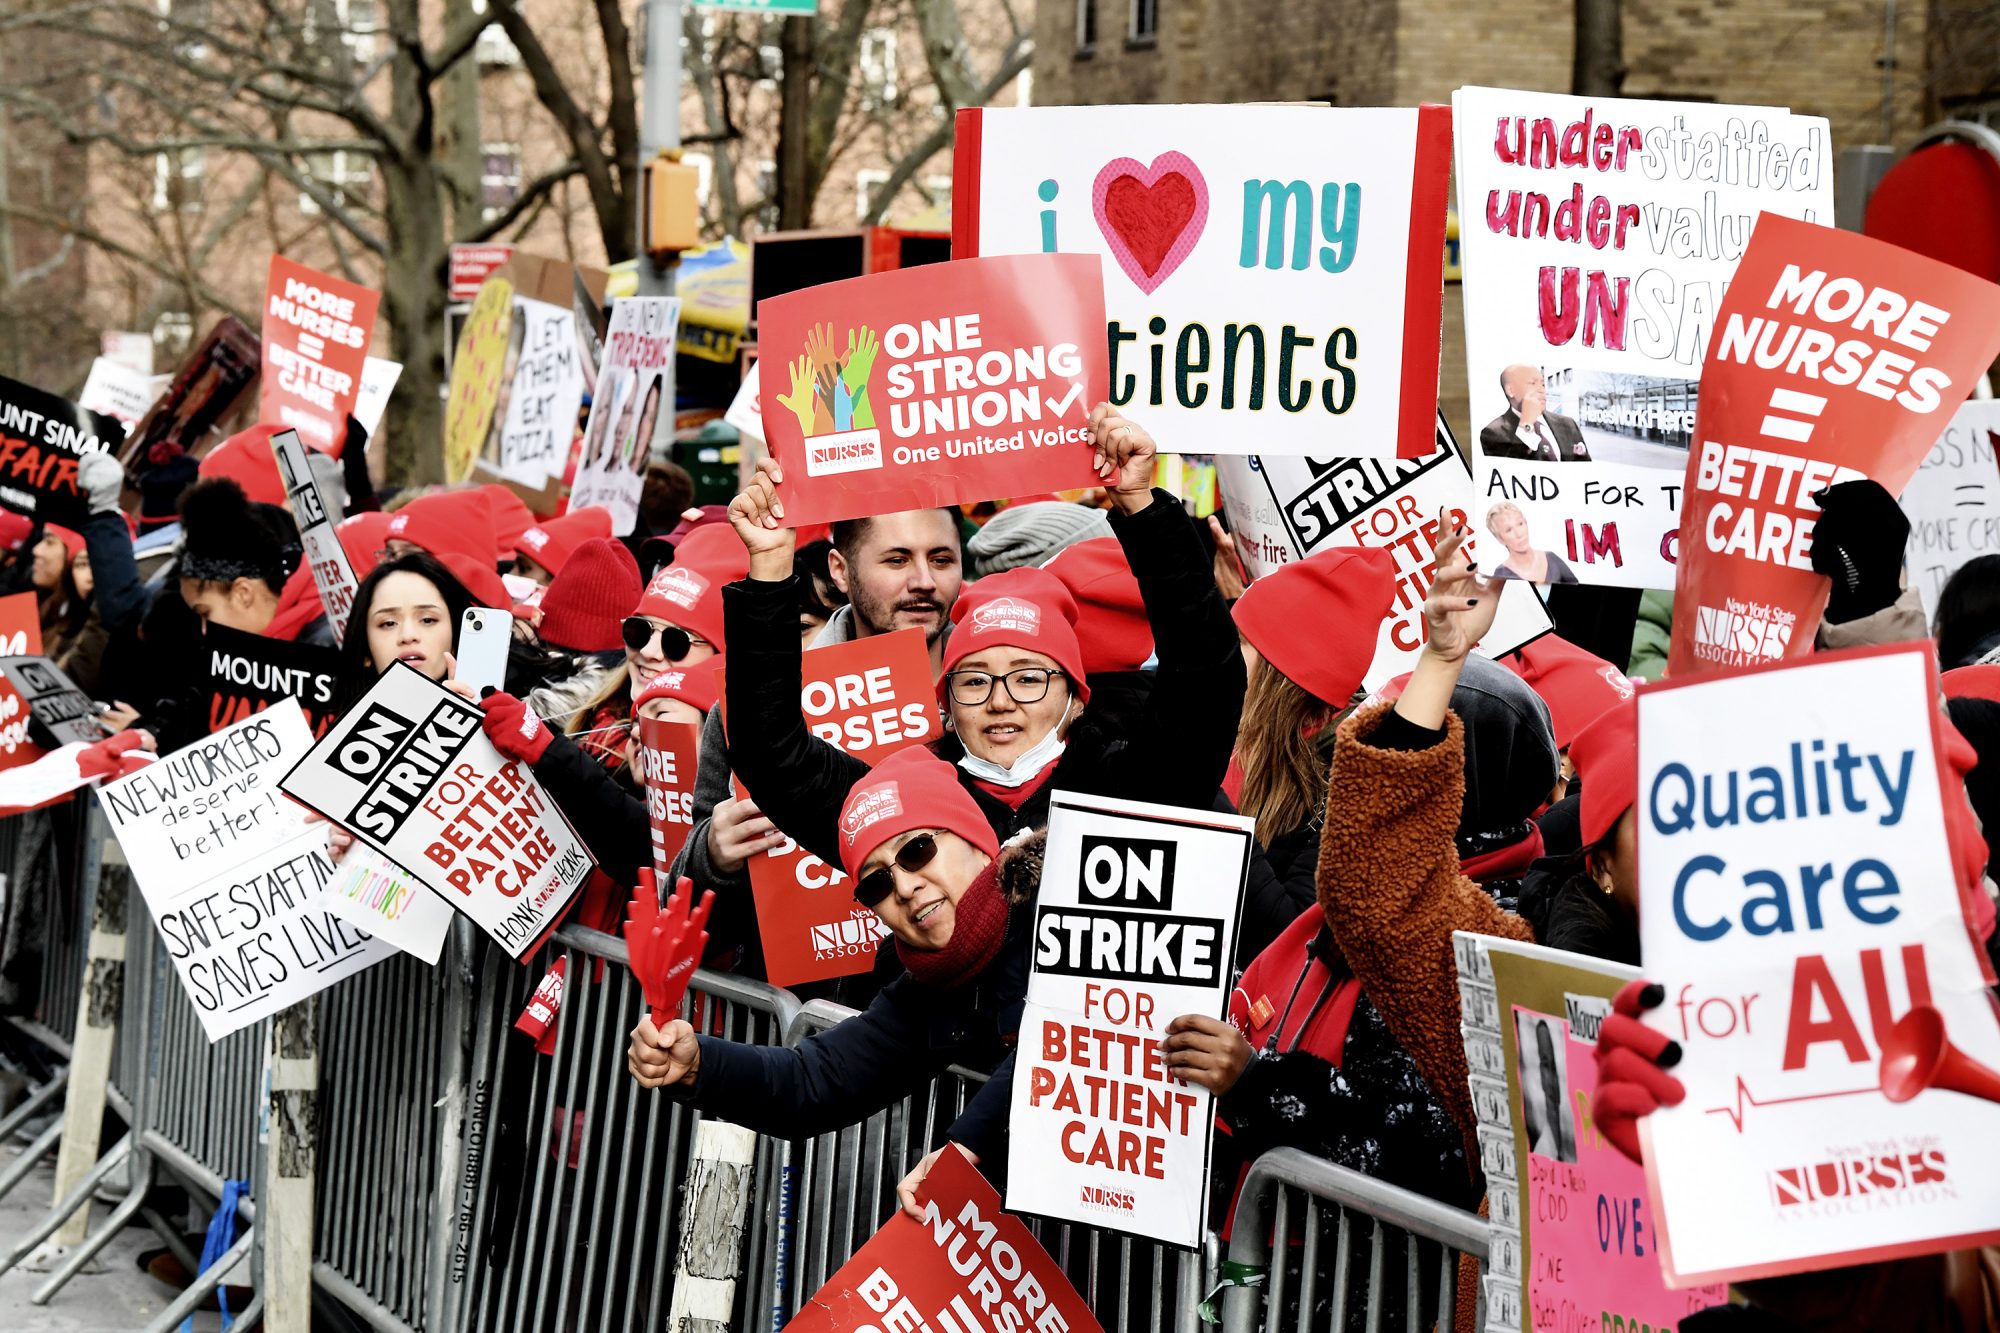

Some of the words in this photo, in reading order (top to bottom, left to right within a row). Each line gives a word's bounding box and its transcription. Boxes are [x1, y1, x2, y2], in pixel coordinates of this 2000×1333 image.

[1494, 107, 1821, 192] understaffed
[1240, 179, 1362, 274] my
[1486, 182, 1755, 262] undervalu
[270, 294, 364, 349] NURSES
[284, 277, 355, 322] MORE
[1538, 266, 1727, 367] UNSA
[1767, 264, 1951, 353] MORE
[533, 316, 567, 352] LET
[883, 313, 982, 359] ONE
[269, 343, 353, 396] BETTER
[278, 369, 335, 412] CARE
[887, 343, 1082, 399] STRONG
[1108, 316, 1358, 416] tients
[1717, 313, 1952, 415] NURSES
[0, 402, 45, 437] UNT
[523, 392, 557, 425] EAT
[890, 386, 1042, 438] UNION
[0, 432, 79, 497] FAIR
[812, 442, 876, 464] NURSES
[893, 446, 940, 465] One
[946, 431, 1024, 458] United
[1028, 425, 1089, 448] Voice
[1487, 468, 1559, 501] AND
[1584, 481, 1644, 508] FOR
[1351, 495, 1423, 547] FOR
[1564, 518, 1624, 569] IM
[1705, 502, 1815, 572] CARE
[1695, 605, 1794, 660] NURSES
[1725, 597, 1749, 615] New
[1748, 601, 1772, 620] York
[211, 650, 311, 698] MOUNT
[799, 666, 895, 716] ORE
[340, 712, 407, 775] ON
[812, 703, 929, 753] RSES
[355, 704, 478, 839] STRIKE
[423, 763, 485, 821] FOR
[643, 745, 678, 784] ORE
[1649, 739, 1915, 836] Quality
[162, 772, 261, 827] deserve
[170, 792, 279, 860] better!
[424, 762, 526, 870] BETTER
[646, 784, 694, 825] RSES
[446, 783, 546, 897] PATIENT
[494, 826, 557, 898] CARE
[553, 842, 585, 886] HONK
[1084, 845, 1165, 903] ON
[1672, 854, 1902, 942] Care
[493, 896, 544, 949] HONK
[1037, 913, 1215, 980] STRIKE
[189, 932, 288, 1011] SAVES
[1084, 983, 1155, 1031] FOR
[1675, 984, 1760, 1041] for
[1030, 1066, 1197, 1136] PATIENT
[1061, 1121, 1165, 1180] CARE
[1766, 1149, 1948, 1207] NURSES
[1080, 1185, 1135, 1211] NURSES
[1597, 1193, 1656, 1258] OVE
[957, 1199, 1069, 1333] MORE
